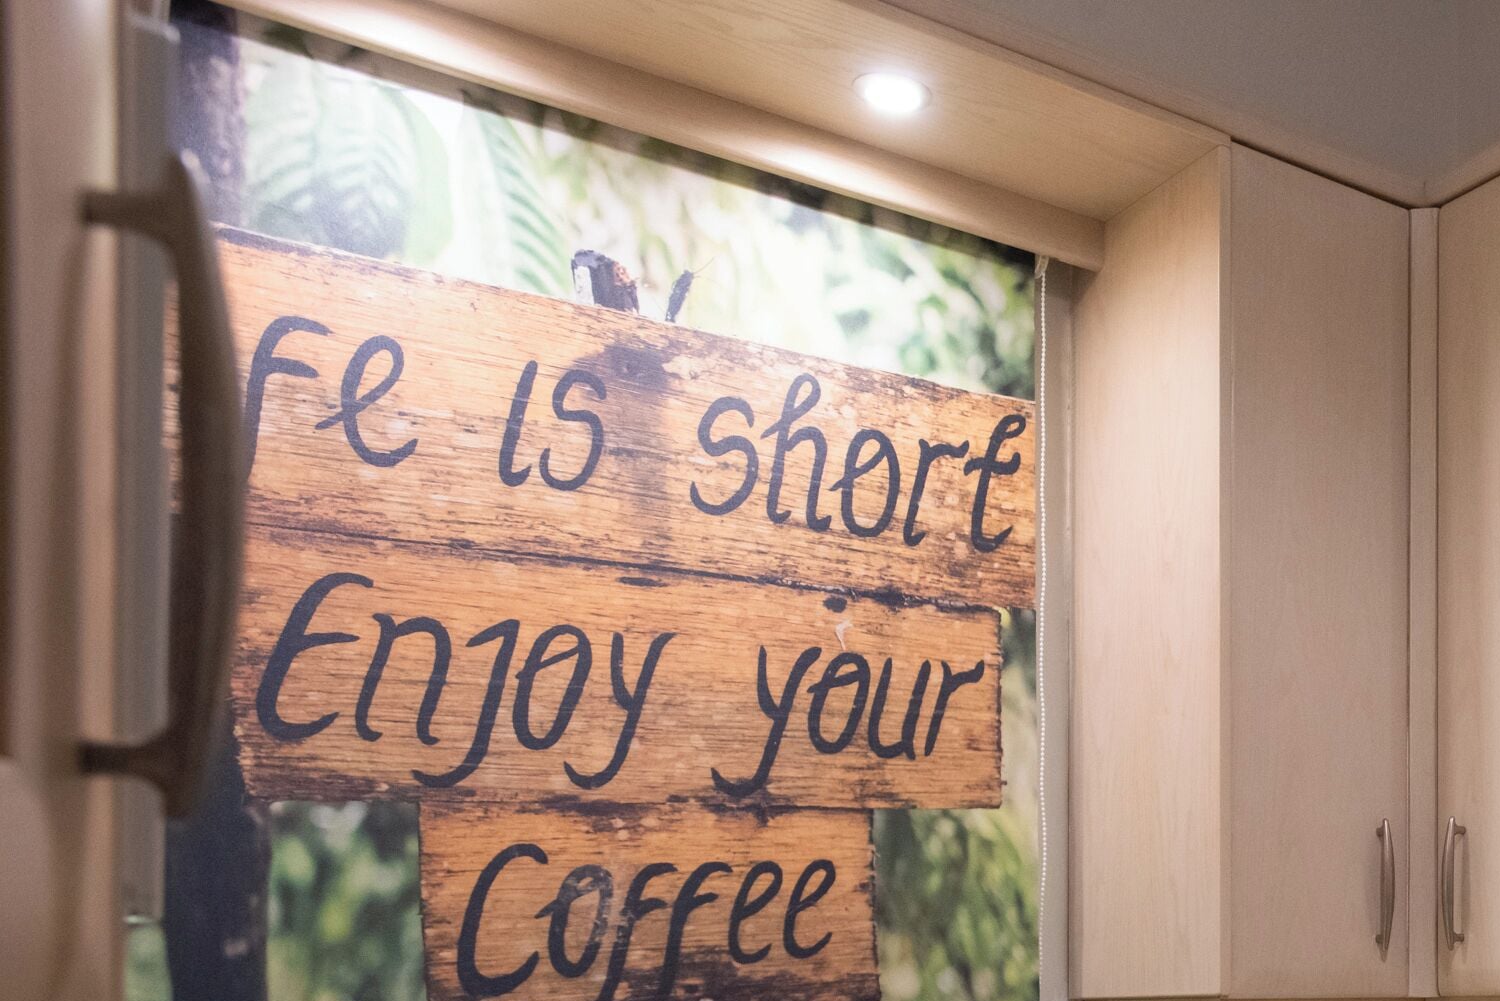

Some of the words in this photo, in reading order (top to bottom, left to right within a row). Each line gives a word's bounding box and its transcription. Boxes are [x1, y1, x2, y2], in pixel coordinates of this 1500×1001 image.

[246, 315, 419, 482] fe
[690, 373, 1027, 553] short
[256, 572, 677, 790] Enjoy
[710, 644, 985, 796] your
